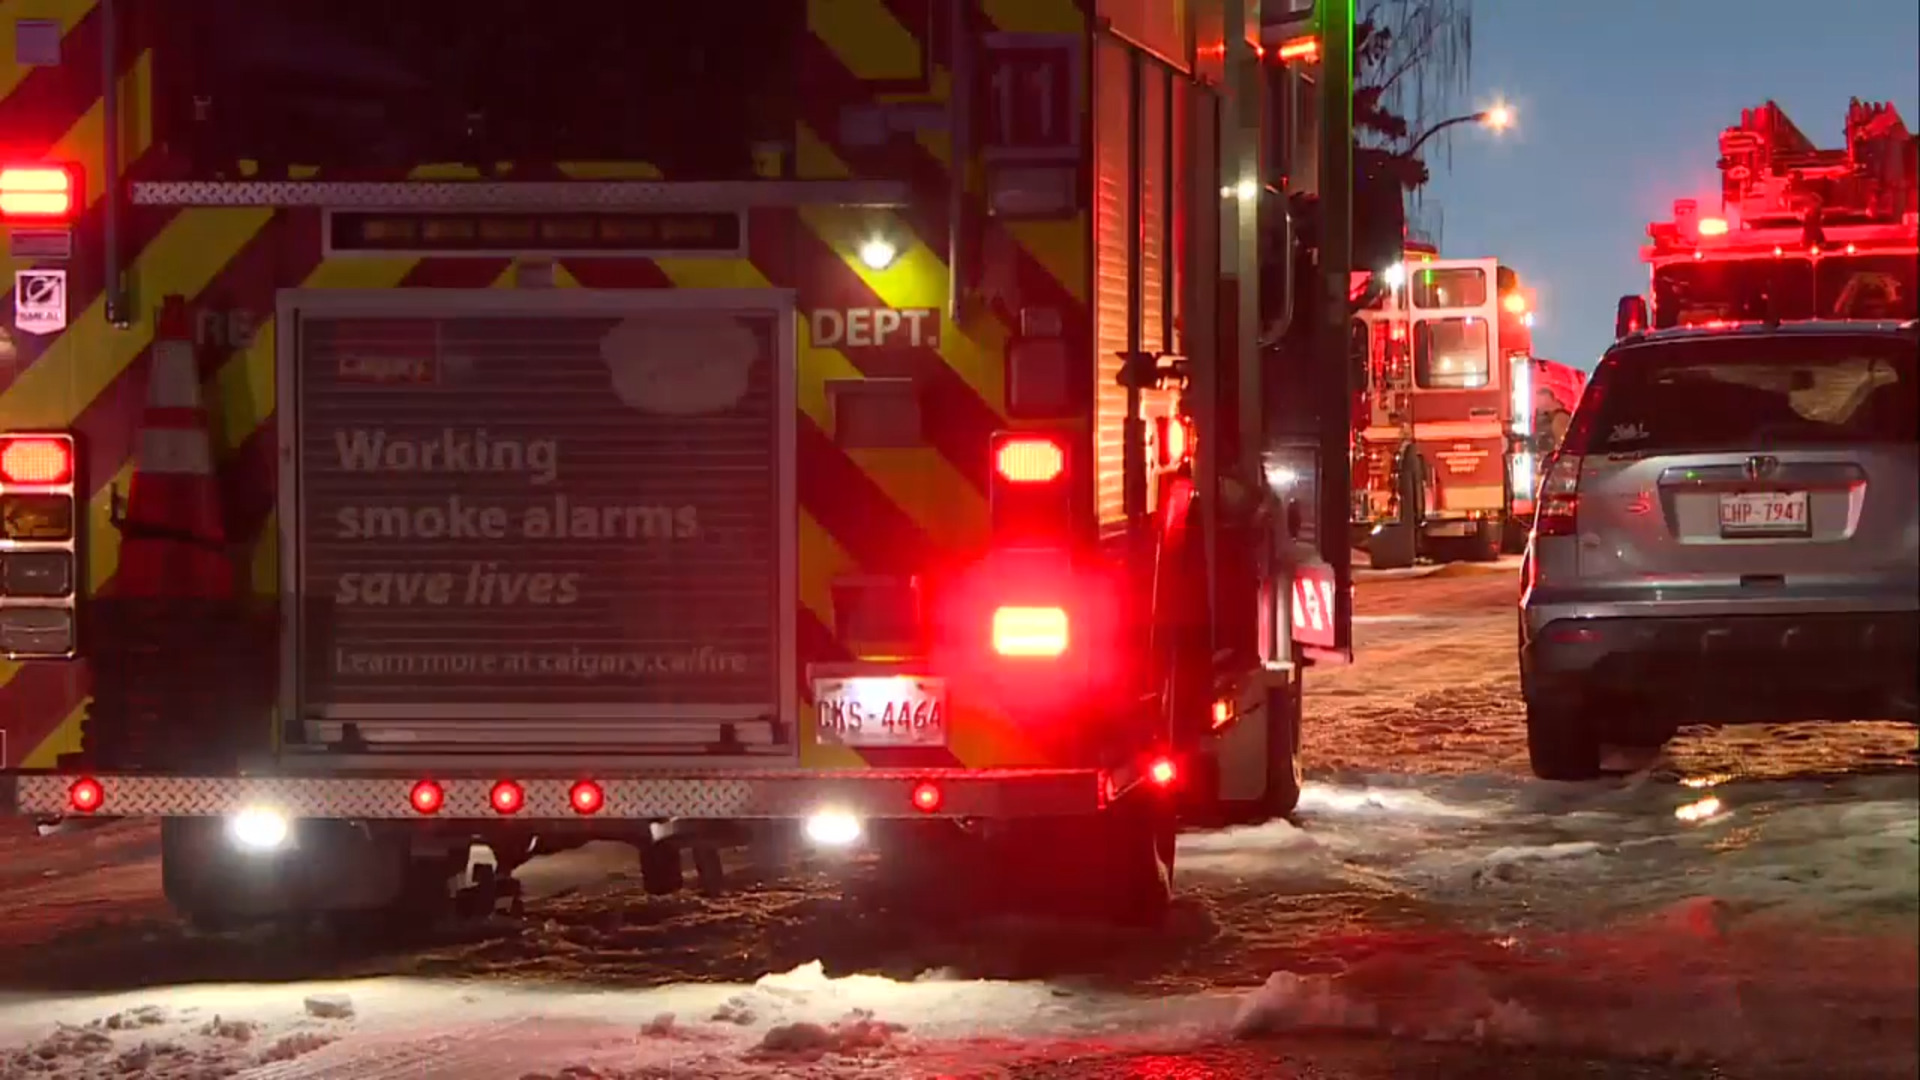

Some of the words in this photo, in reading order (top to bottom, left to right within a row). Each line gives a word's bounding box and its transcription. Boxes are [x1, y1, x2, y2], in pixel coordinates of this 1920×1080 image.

[196, 310, 254, 346] RE
[812, 308, 938, 347] DEPT.
[334, 428, 558, 484] Working
[335, 496, 507, 539] smoke
[522, 496, 698, 539] alarms
[1721, 501, 1804, 523] CHP-7947
[335, 571, 453, 606] save
[463, 562, 580, 605] lives
[335, 649, 415, 674] Learn
[423, 652, 495, 674] more
[503, 650, 532, 674] at
[817, 699, 942, 732] CKS-4464
